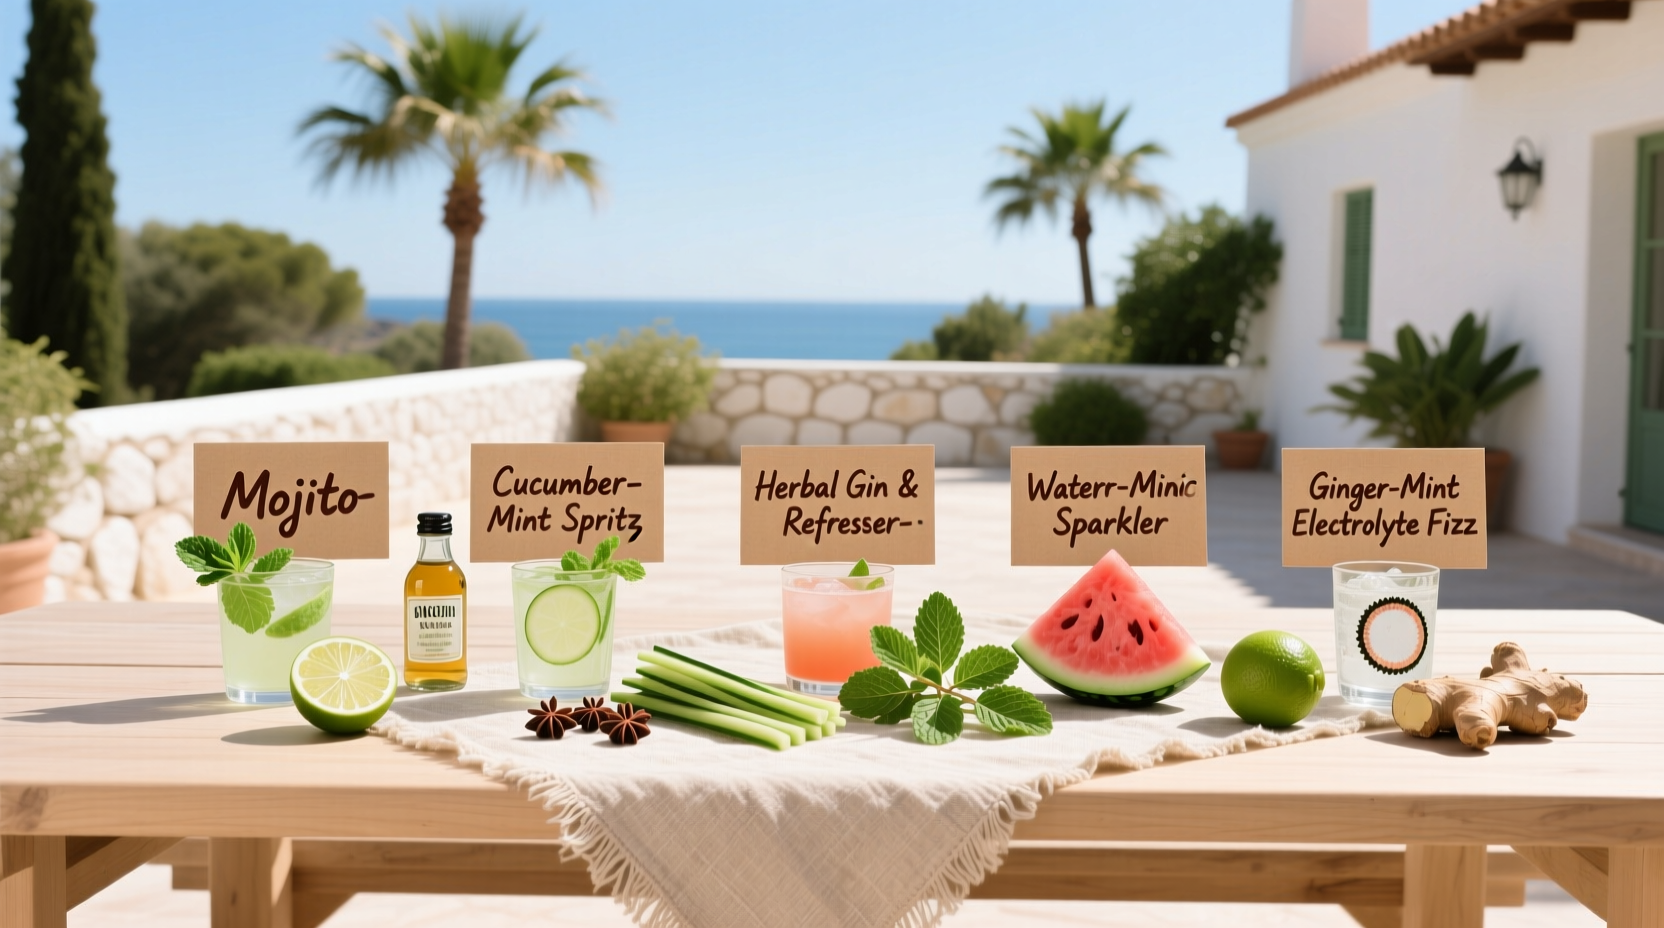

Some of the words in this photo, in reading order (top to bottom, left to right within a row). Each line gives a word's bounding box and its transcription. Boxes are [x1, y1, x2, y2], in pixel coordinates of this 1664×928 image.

[492, 464, 643, 498] Cucumber-
[754, 468, 840, 502] Herbal
[846, 468, 889, 499] Gin
[898, 468, 919, 499] &
[1308, 470, 1460, 512] Ginger-Mint
[220, 469, 376, 539] Mojito-
[486, 503, 552, 533] Mint
[1052, 505, 1169, 549] Sparkler
[1291, 507, 1420, 548] Electrolyte
[1425, 507, 1478, 537] Fizz
